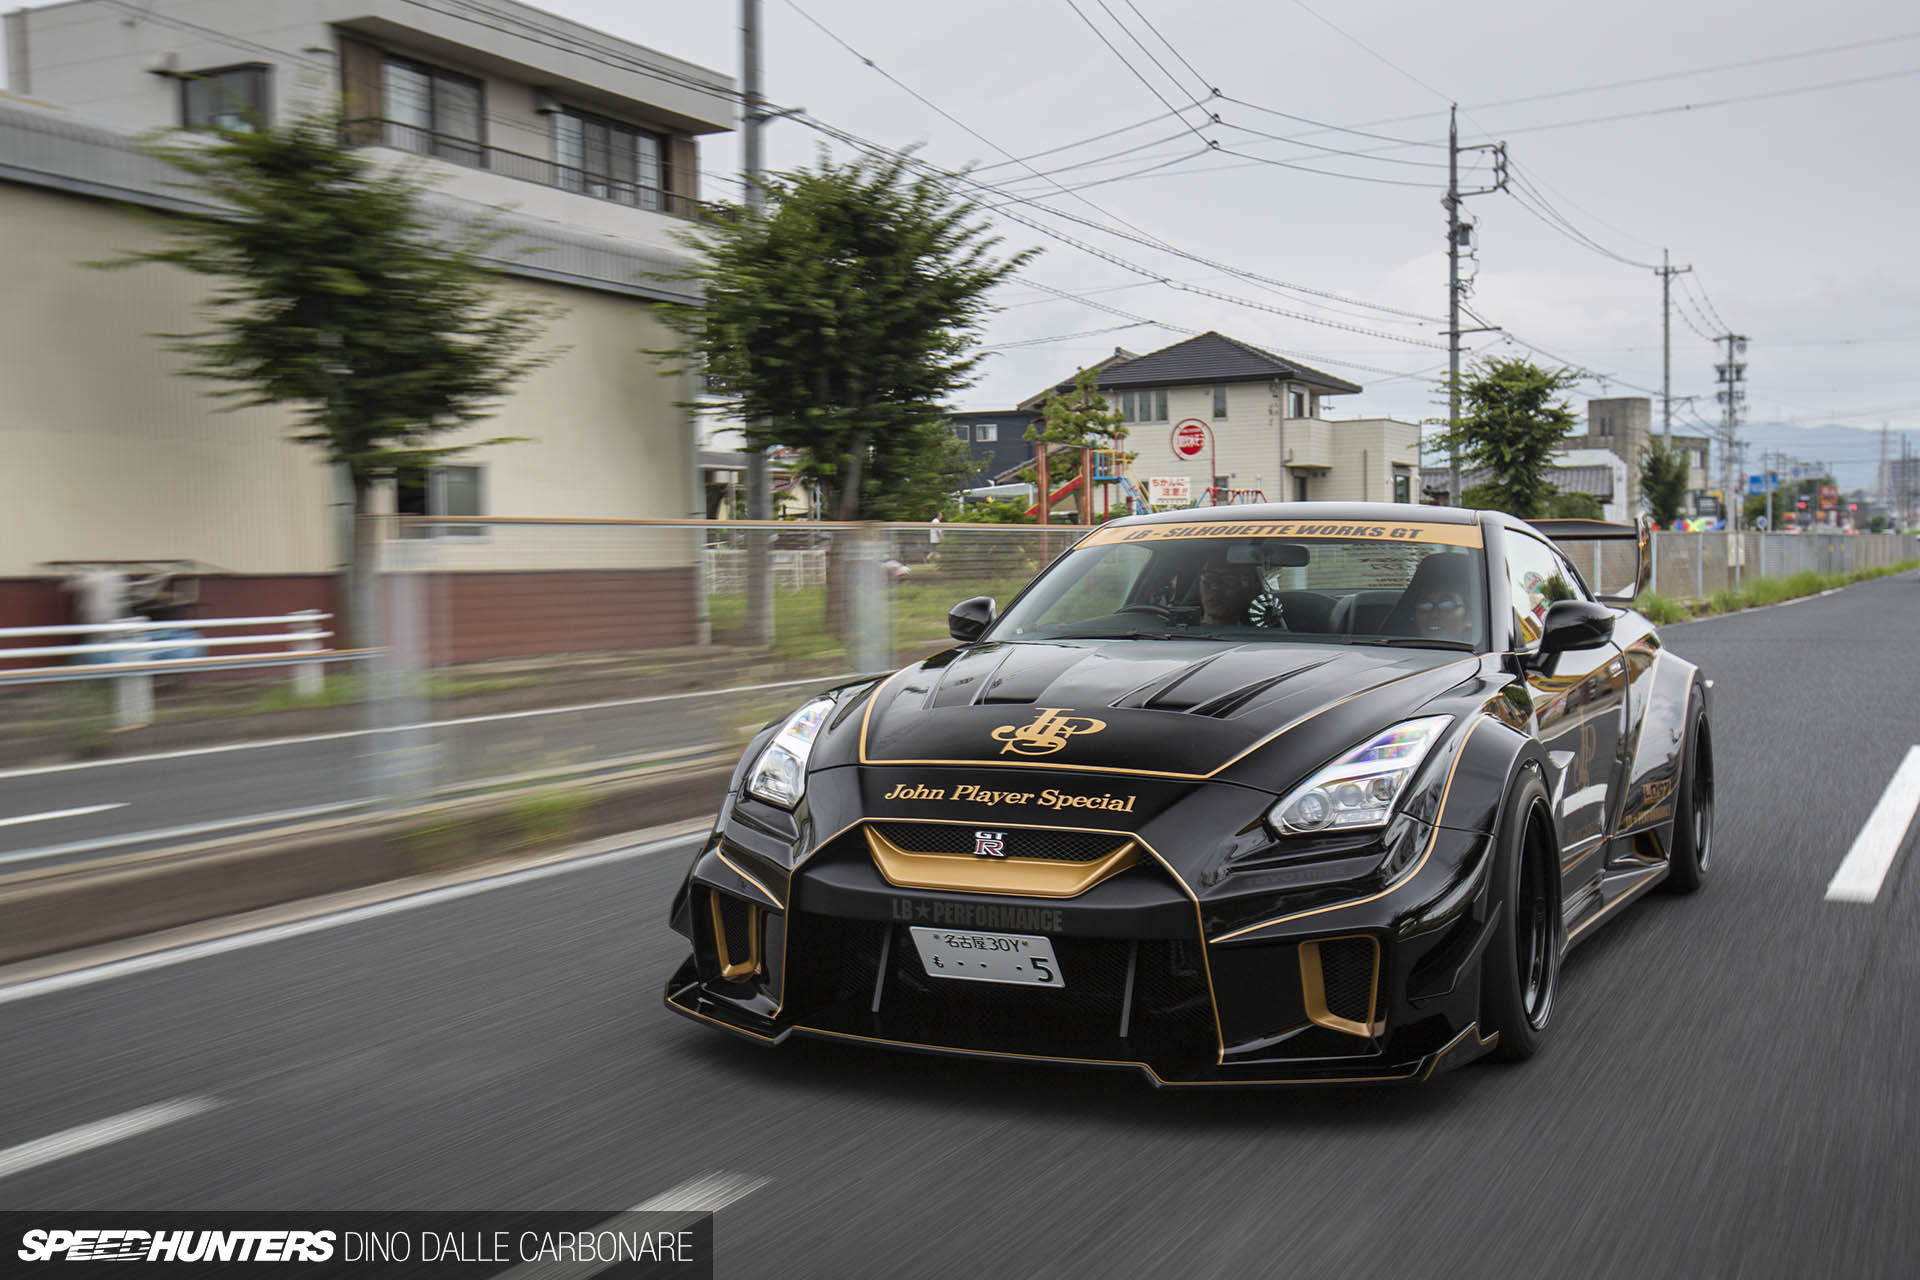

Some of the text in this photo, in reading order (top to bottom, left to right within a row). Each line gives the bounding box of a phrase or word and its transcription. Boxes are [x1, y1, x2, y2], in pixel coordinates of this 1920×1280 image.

[1163, 525, 1295, 538] SILHOUETTE
[1296, 525, 1385, 537] WORKS
[1390, 528, 1423, 539] GT
[884, 784, 1137, 813] John Player Special
[975, 831, 1008, 840] GT
[973, 839, 1004, 857] R
[892, 899, 1064, 932] LB PERFORMANCE
